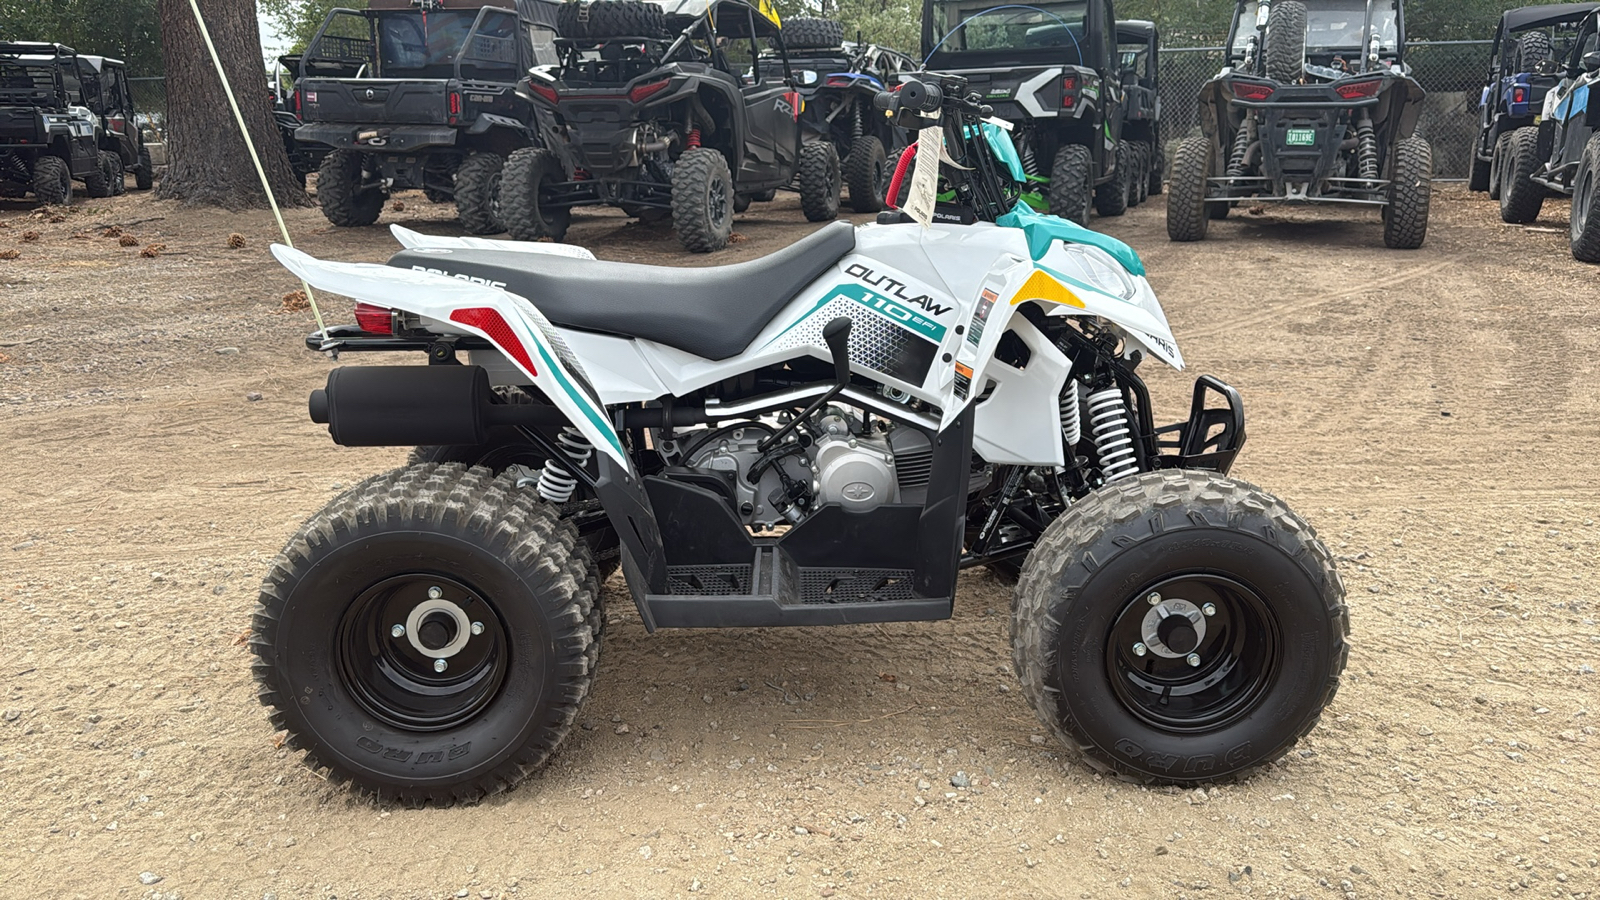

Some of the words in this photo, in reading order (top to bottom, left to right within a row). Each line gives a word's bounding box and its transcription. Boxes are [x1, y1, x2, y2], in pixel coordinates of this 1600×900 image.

[844, 263, 954, 316] OUTLAW
[861, 291, 913, 321] 110
[912, 315, 937, 331] EFI
[356, 735, 472, 765] DURO
